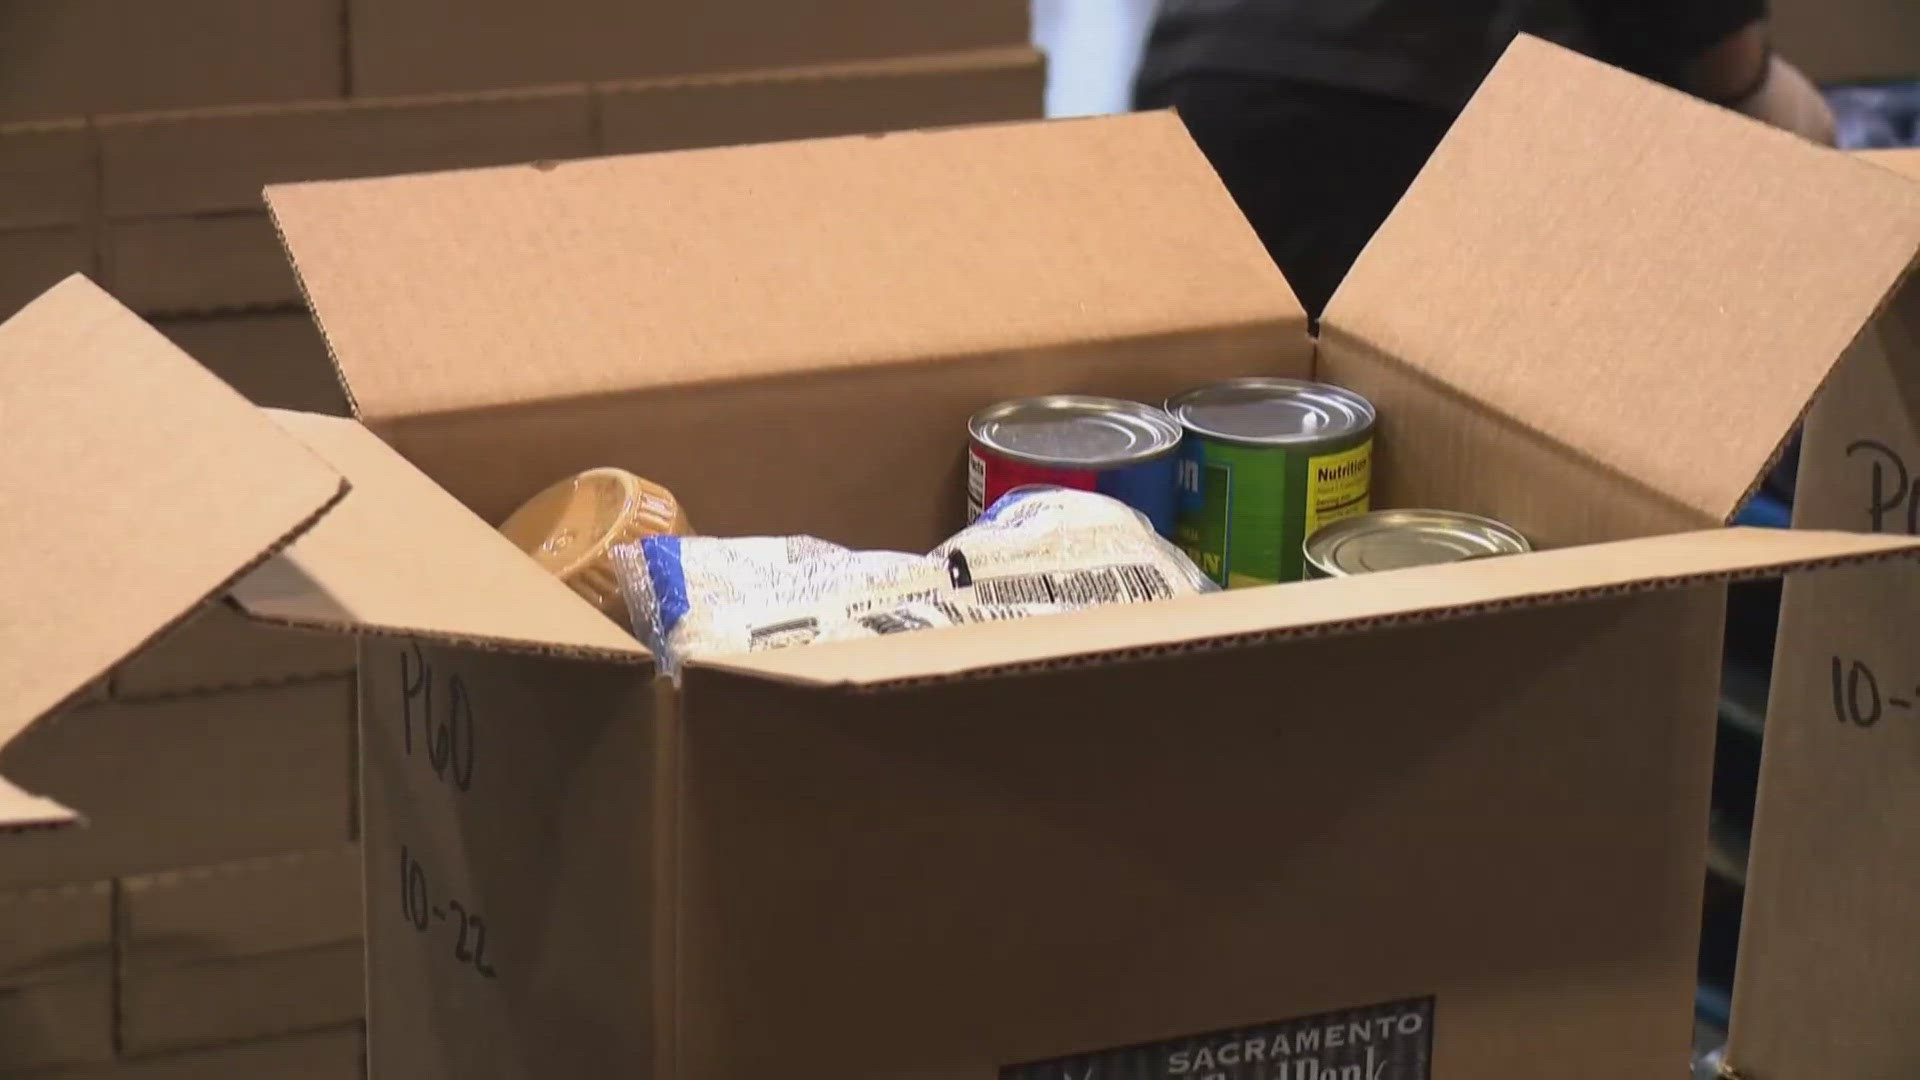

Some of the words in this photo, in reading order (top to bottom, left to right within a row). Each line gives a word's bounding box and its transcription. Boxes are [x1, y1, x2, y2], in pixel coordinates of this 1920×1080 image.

[1317, 458, 1367, 483] Nutrition
[1832, 655, 1920, 728] 10-
[400, 845, 497, 978] 10-22
[1168, 1012, 1423, 1074] SACRAMENTO
